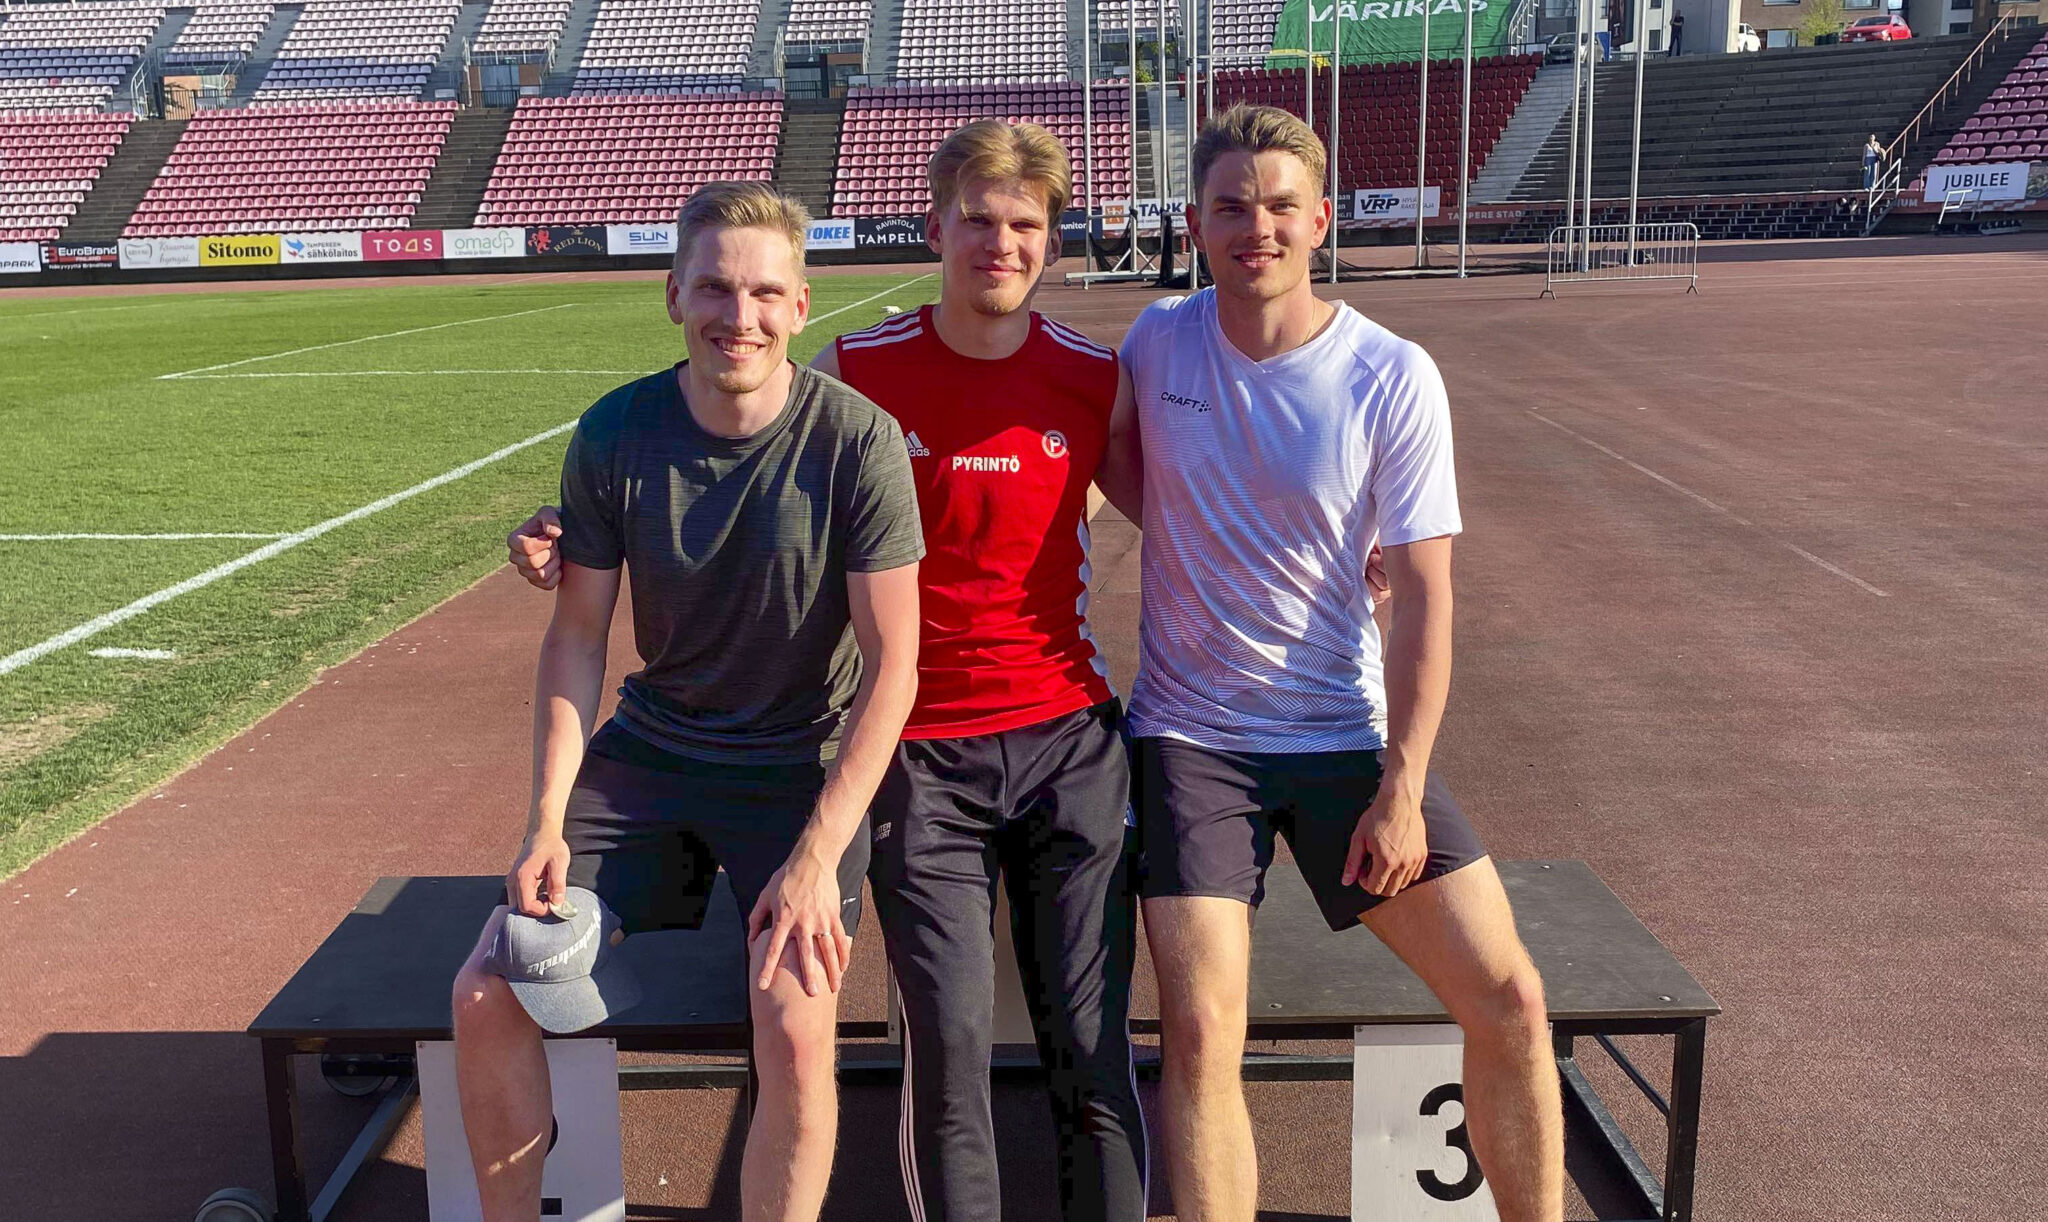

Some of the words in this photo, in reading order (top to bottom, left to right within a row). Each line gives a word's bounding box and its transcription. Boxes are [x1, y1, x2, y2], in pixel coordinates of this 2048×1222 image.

[1942, 172, 2010, 191] JUBILEE
[1139, 202, 1183, 216] TAK
[1361, 198, 1400, 210] VRP
[1448, 210, 1494, 220] TAPERE
[875, 219, 915, 232] RAVINTOLA
[629, 231, 668, 242] SUN
[857, 232, 925, 244] TAMPELL
[58, 245, 117, 256] EuroBrand
[208, 242, 274, 258] Sitomo
[553, 237, 576, 253] RED
[578, 236, 604, 252] LION
[307, 247, 359, 258] sähkölaitos
[1160, 391, 1201, 409] CRAFT
[908, 447, 930, 457] das
[952, 454, 1021, 473] PYRINTÖ
[1416, 1082, 1486, 1201] 3
